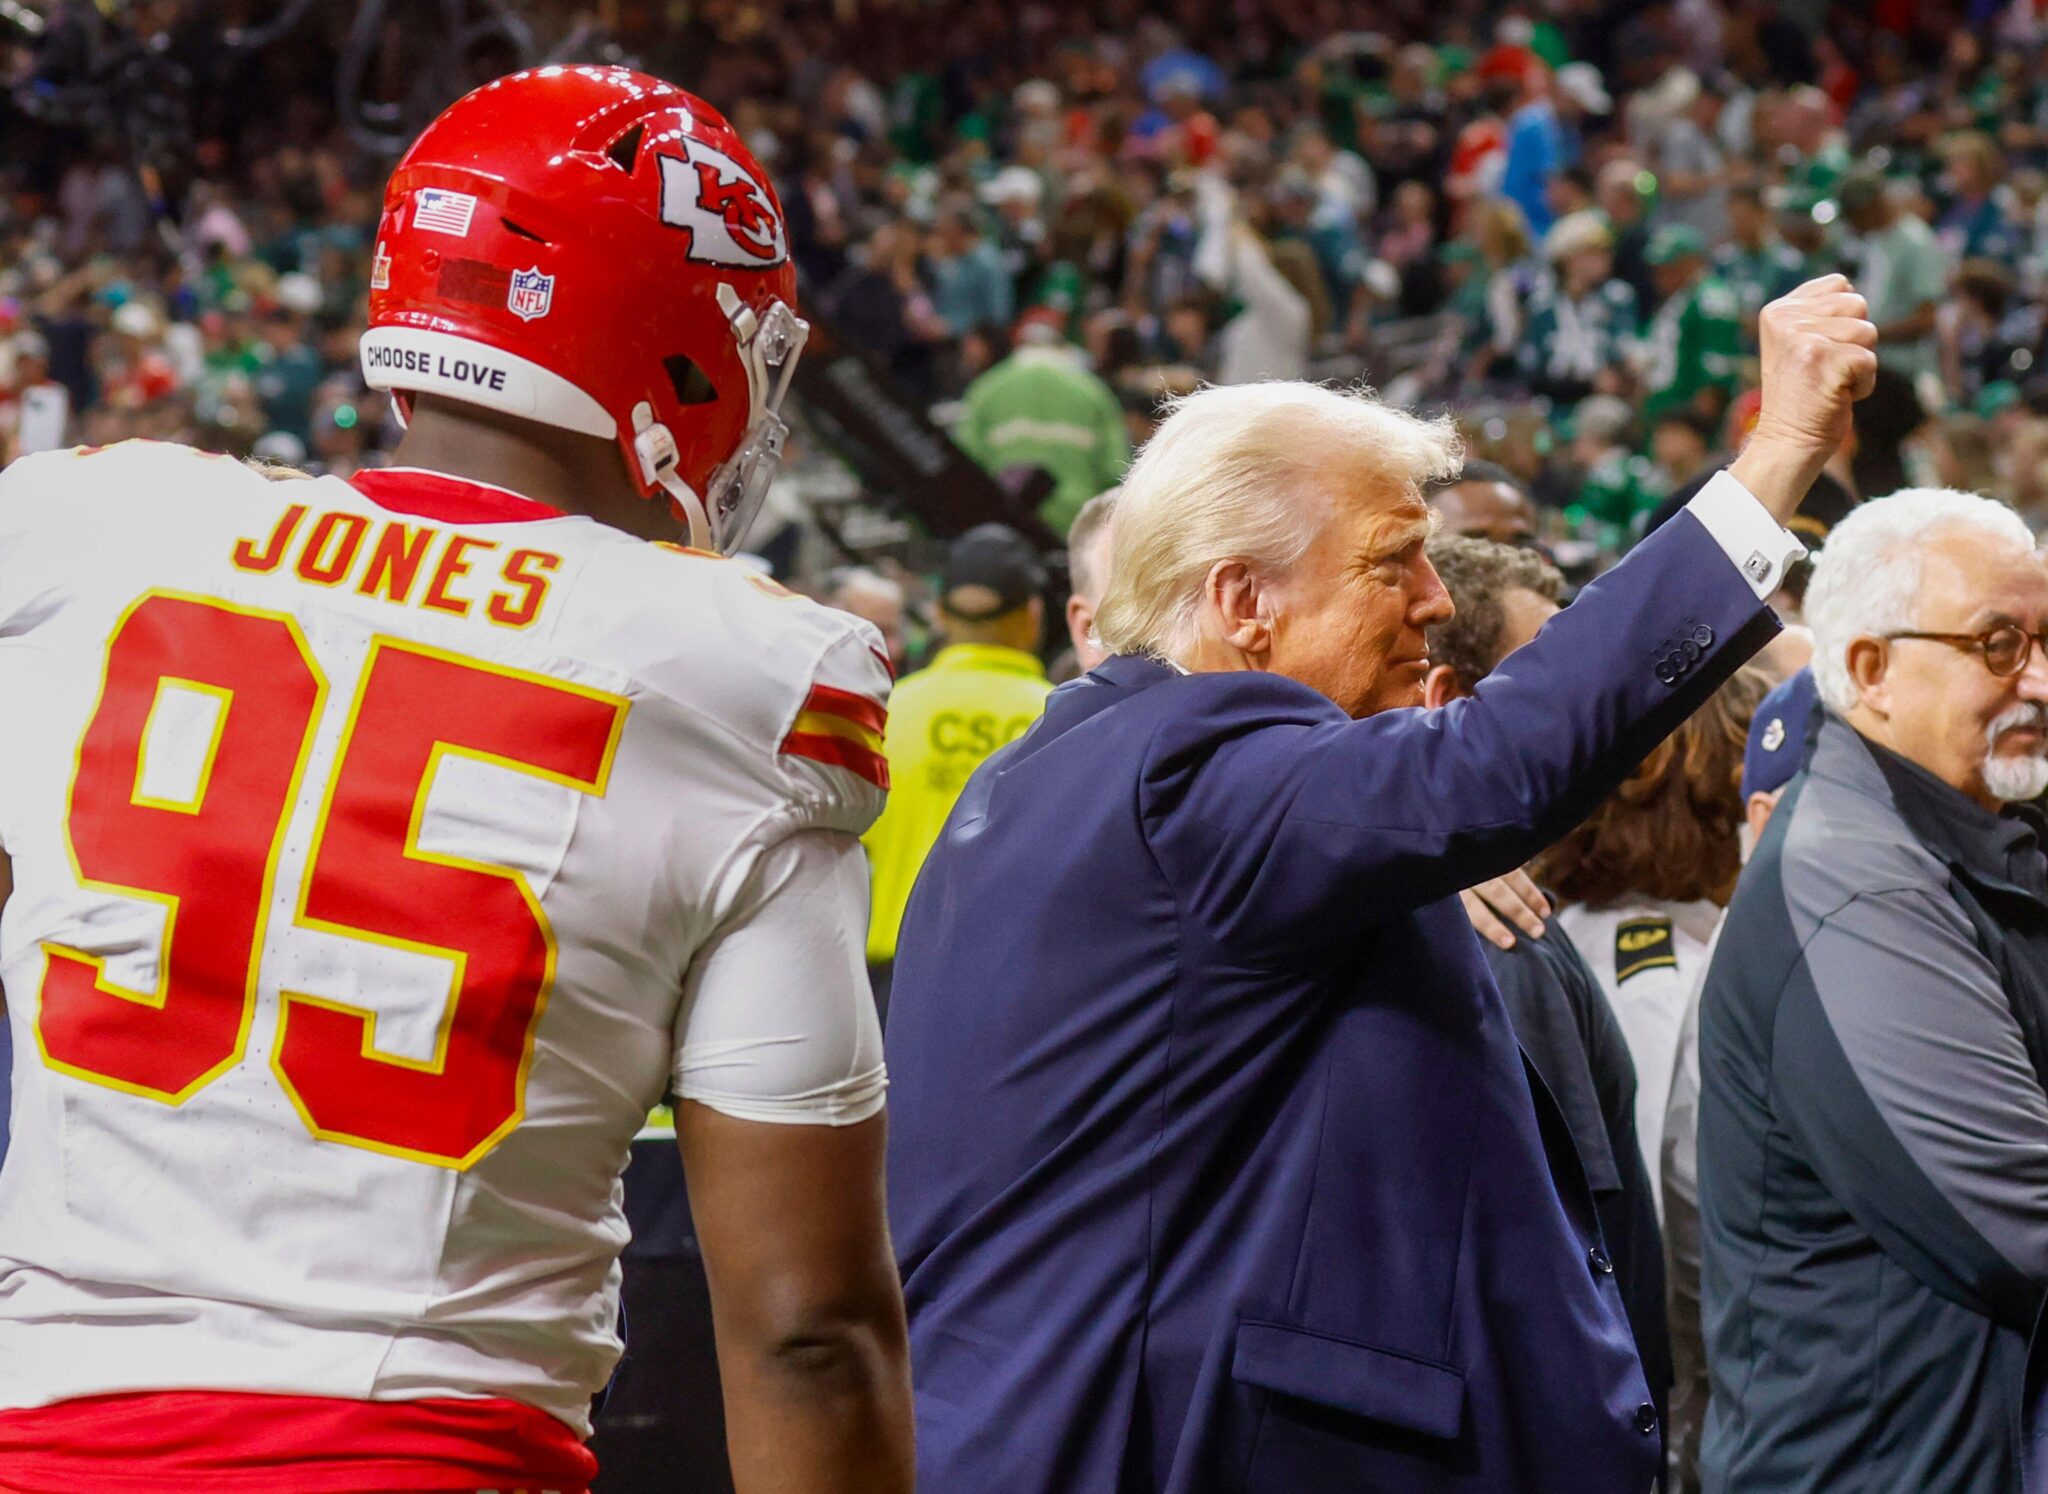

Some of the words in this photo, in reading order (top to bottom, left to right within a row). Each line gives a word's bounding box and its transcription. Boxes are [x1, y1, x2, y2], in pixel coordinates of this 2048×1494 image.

[693, 161, 777, 260] KC
[514, 289, 544, 311] NFL
[368, 346, 430, 373] CHOOSE
[438, 356, 506, 391] LOVE
[230, 504, 564, 630] JONES
[34, 586, 633, 1171] 95
